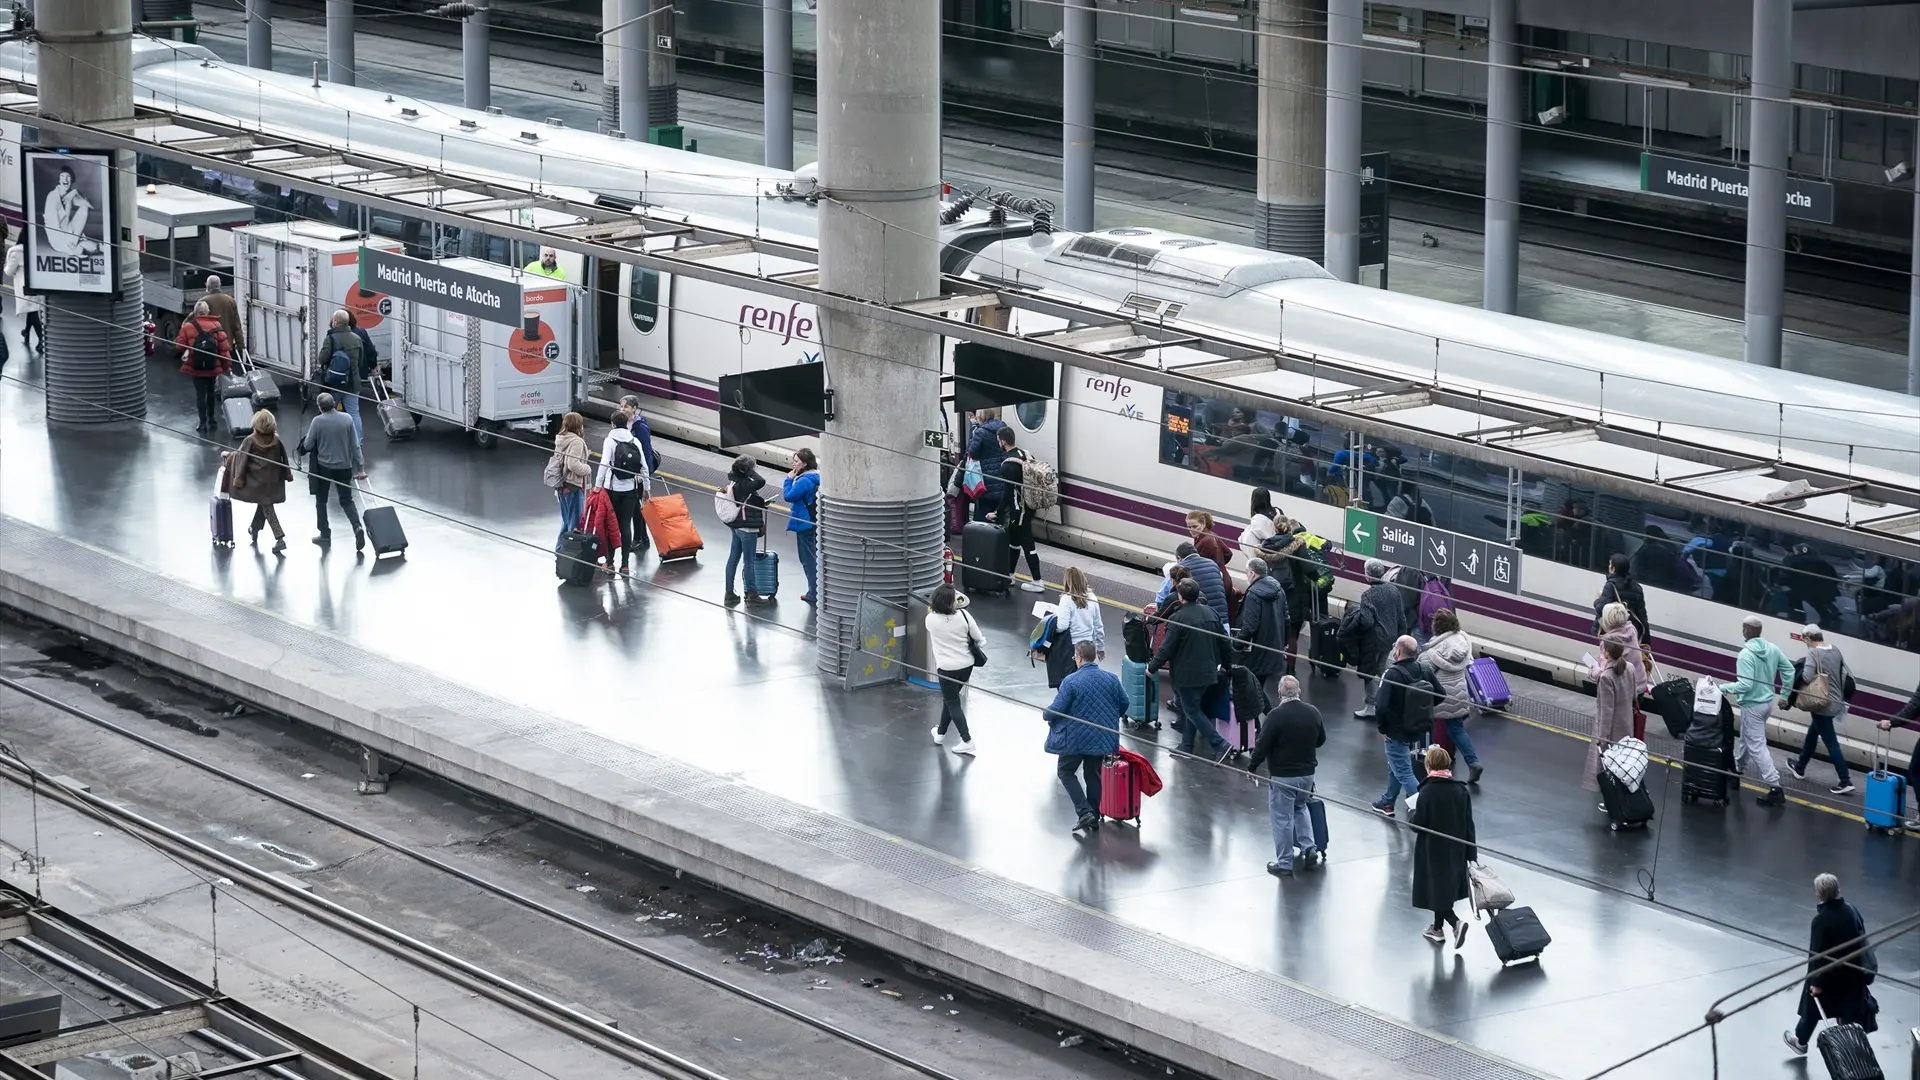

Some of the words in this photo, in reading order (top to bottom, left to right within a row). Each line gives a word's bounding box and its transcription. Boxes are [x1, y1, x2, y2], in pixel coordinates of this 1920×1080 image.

[1667, 170, 1707, 190] Madrid
[1711, 178, 1748, 197] Puerta
[1786, 191, 1811, 208] ocha
[36, 255, 103, 275] MEISEL
[378, 263, 412, 287] Madrid
[415, 273, 447, 296] Puerta
[450, 282, 463, 297] de
[466, 286, 501, 309] Atocha
[739, 302, 813, 346] renfe
[526, 389, 541, 398] café
[1086, 376, 1132, 402] renfe
[1118, 405, 1144, 420] AVE
[1382, 526, 1415, 546] Salida
[1382, 544, 1395, 553] EXIT
